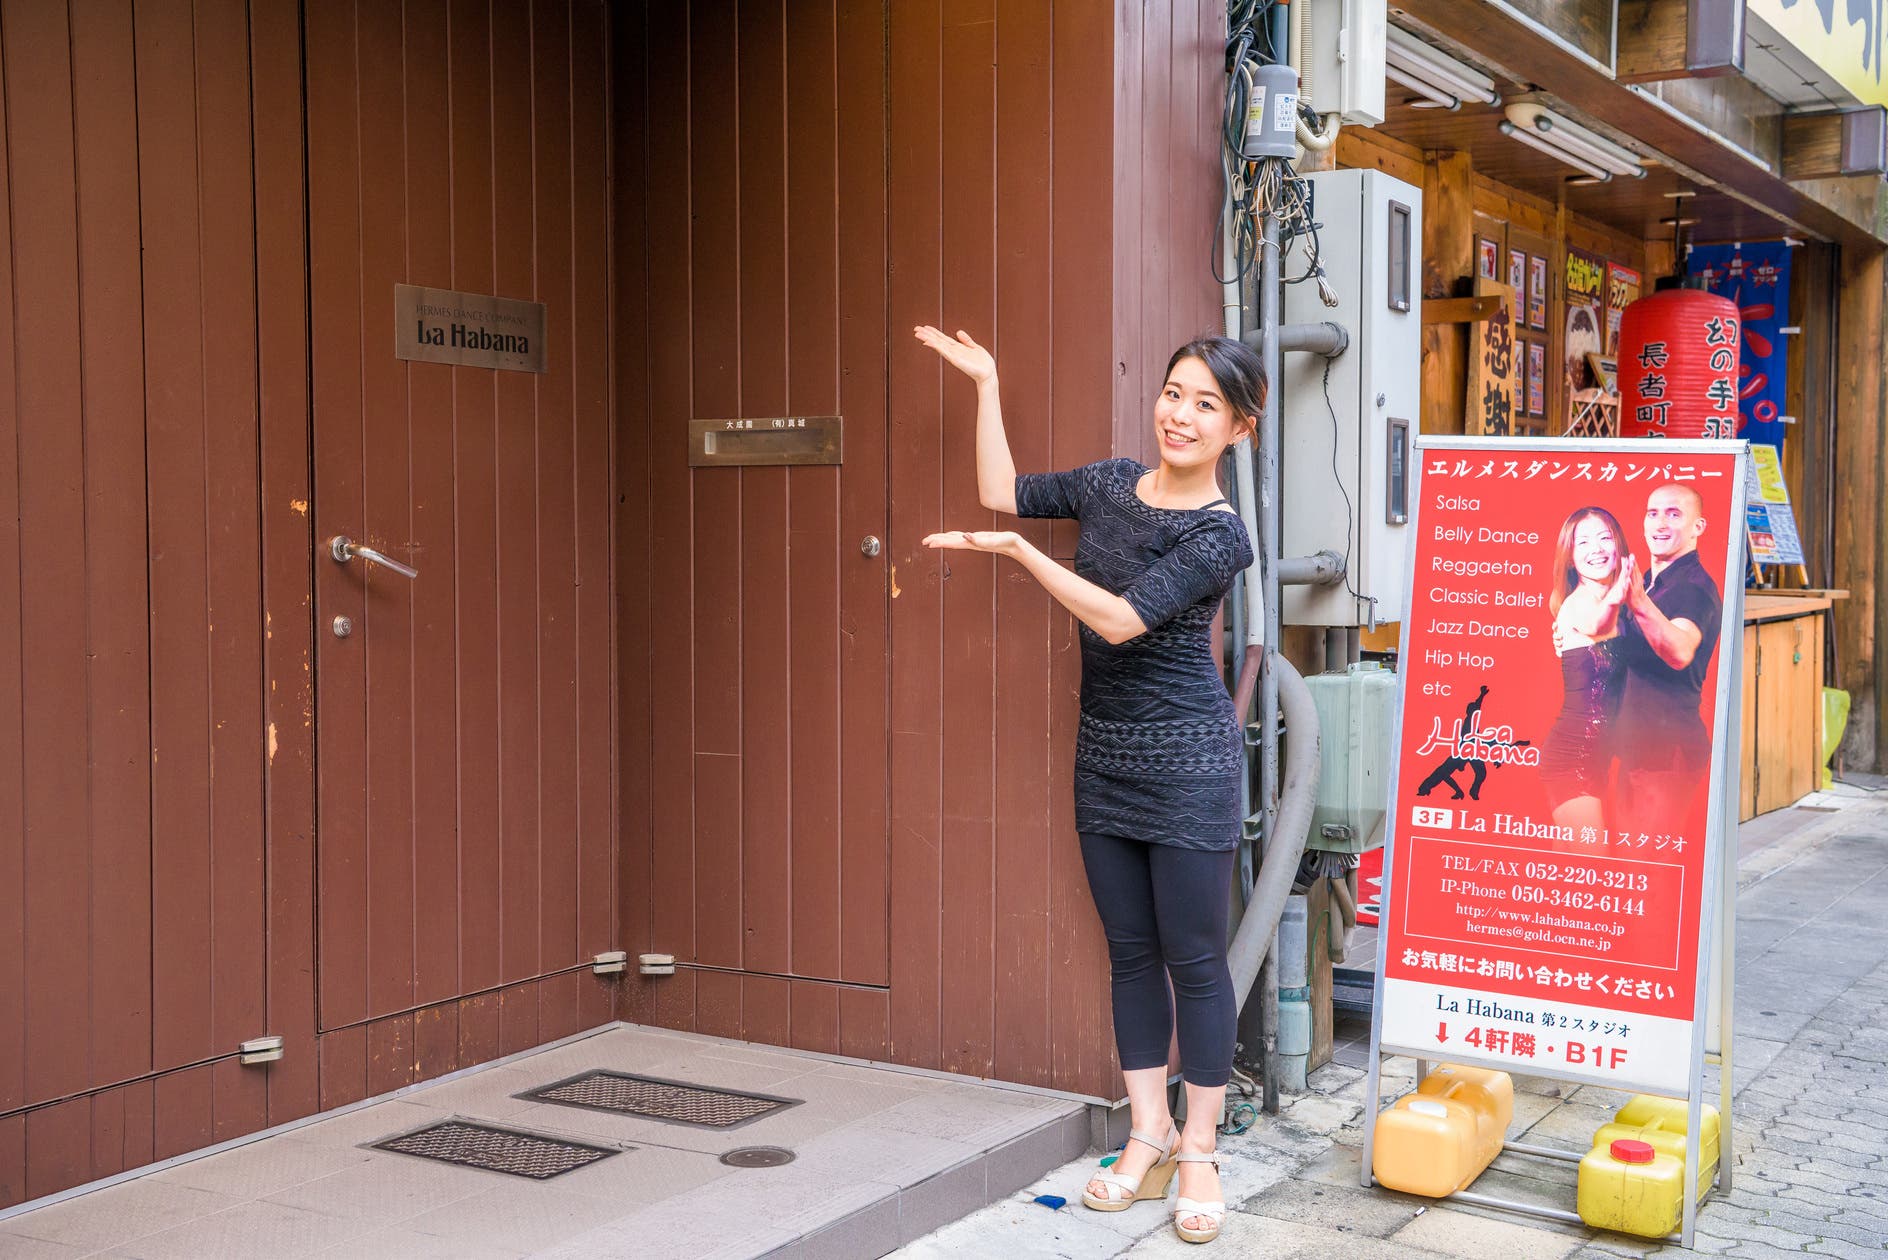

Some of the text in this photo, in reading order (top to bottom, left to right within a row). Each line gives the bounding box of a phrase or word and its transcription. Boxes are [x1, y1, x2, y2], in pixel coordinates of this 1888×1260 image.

[416, 304, 527, 326] HERMES DANCE COMPANY
[417, 320, 529, 354] La Habana
[1483, 304, 1512, 437] 感謝
[1702, 316, 1738, 439] 幻の手羽
[1637, 341, 1672, 438] 長者町
[1427, 459, 1723, 482] エルメスダンスカンパニー
[1436, 495, 1480, 511] Salsa
[1434, 526, 1539, 546] Belly Dance
[1432, 557, 1532, 577] Reggaeton
[1429, 587, 1544, 608] Classic Ballet
[1427, 618, 1529, 639] Jazz Dance
[1425, 649, 1495, 671] Hip Hop
[1422, 681, 1452, 697] etc
[1416, 716, 1540, 767] Habana
[1463, 709, 1513, 744] La
[1418, 810, 1446, 826] 3F
[1459, 810, 1486, 833] La
[1494, 813, 1575, 842] Habana
[1441, 854, 1649, 892] TEL/FAX 052-220-3213
[1440, 878, 1645, 916] IP-Phone 050-3462-6144
[1455, 903, 1625, 936] http://www.lahabana.co.jp
[1466, 920, 1612, 951] hermes@gold.ocn.ne.jp
[1402, 948, 1675, 1001] お気軽にお問い合わせください
[1436, 994, 1459, 1013] La
[1466, 998, 1535, 1024] Habana
